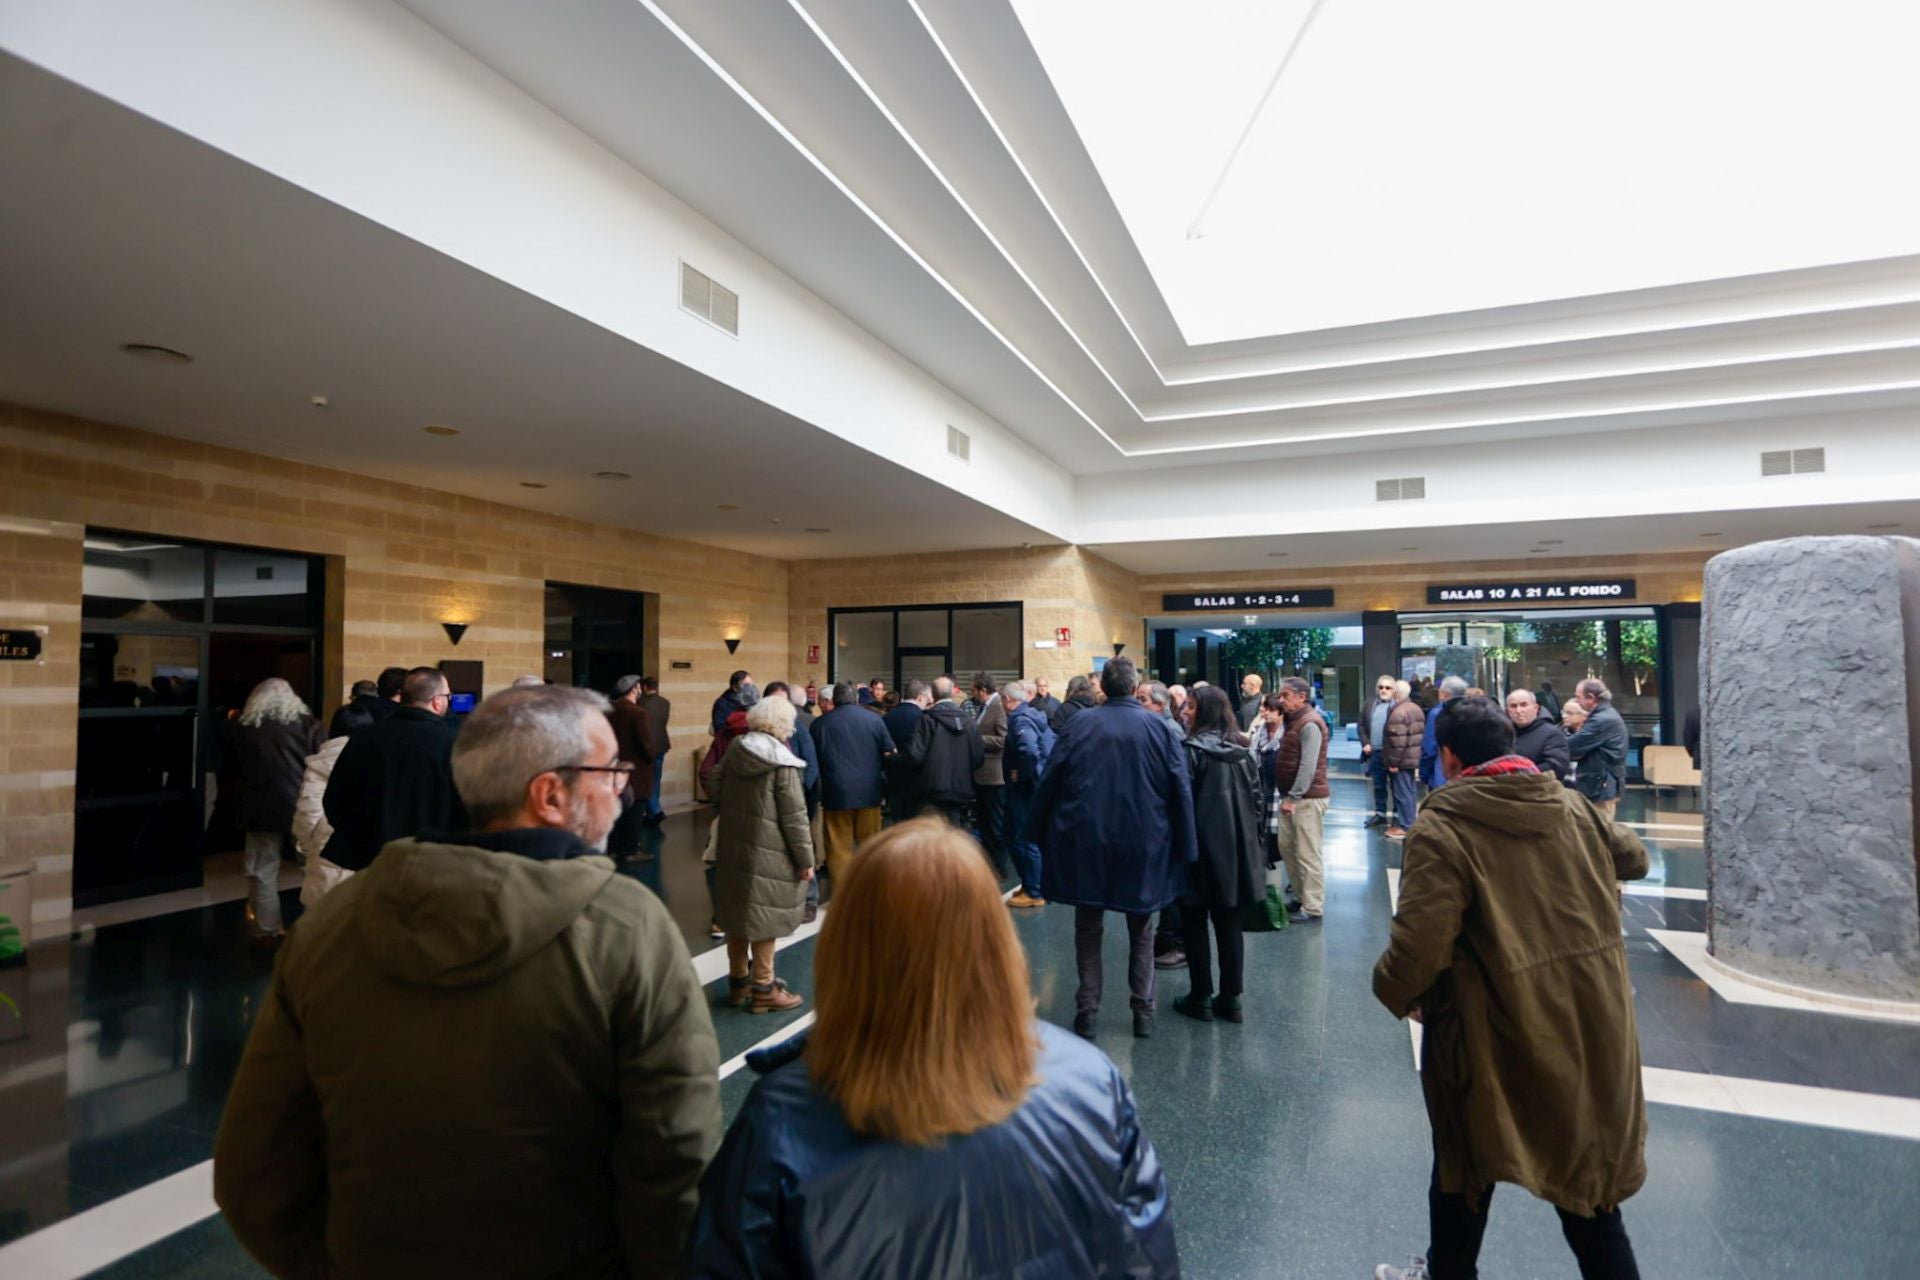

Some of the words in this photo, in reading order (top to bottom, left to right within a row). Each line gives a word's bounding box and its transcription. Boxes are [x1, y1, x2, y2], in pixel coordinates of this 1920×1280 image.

[1440, 587, 1484, 599] SALAS
[1489, 588, 1506, 598] 10
[1511, 587, 1522, 598] A
[1526, 586, 1541, 597] 21
[1546, 586, 1565, 597] AL
[1570, 585, 1622, 596] FONDO
[1194, 596, 1236, 606] SALAS
